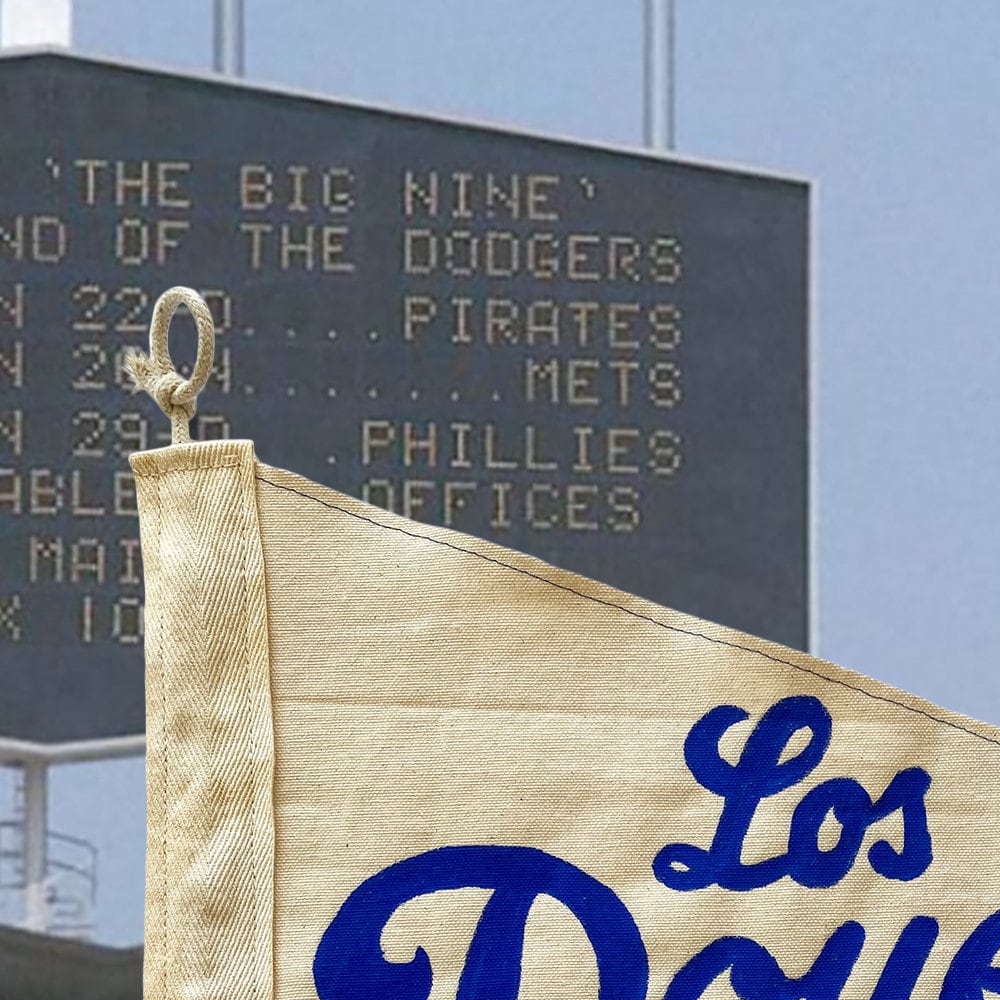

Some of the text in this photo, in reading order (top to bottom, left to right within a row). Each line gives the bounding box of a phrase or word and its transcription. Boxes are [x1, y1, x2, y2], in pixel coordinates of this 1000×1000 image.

[240, 164, 355, 213] BIG
[115, 218, 191, 265] OF
[240, 223, 355, 272] THE
[404, 228, 682, 284] DODGERS
[404, 296, 682, 350] PIRATES
[526, 357, 682, 407] METS
[361, 419, 682, 475] PHILLIES
[361, 478, 640, 532] OFFICES
[653, 696, 933, 892] Los
